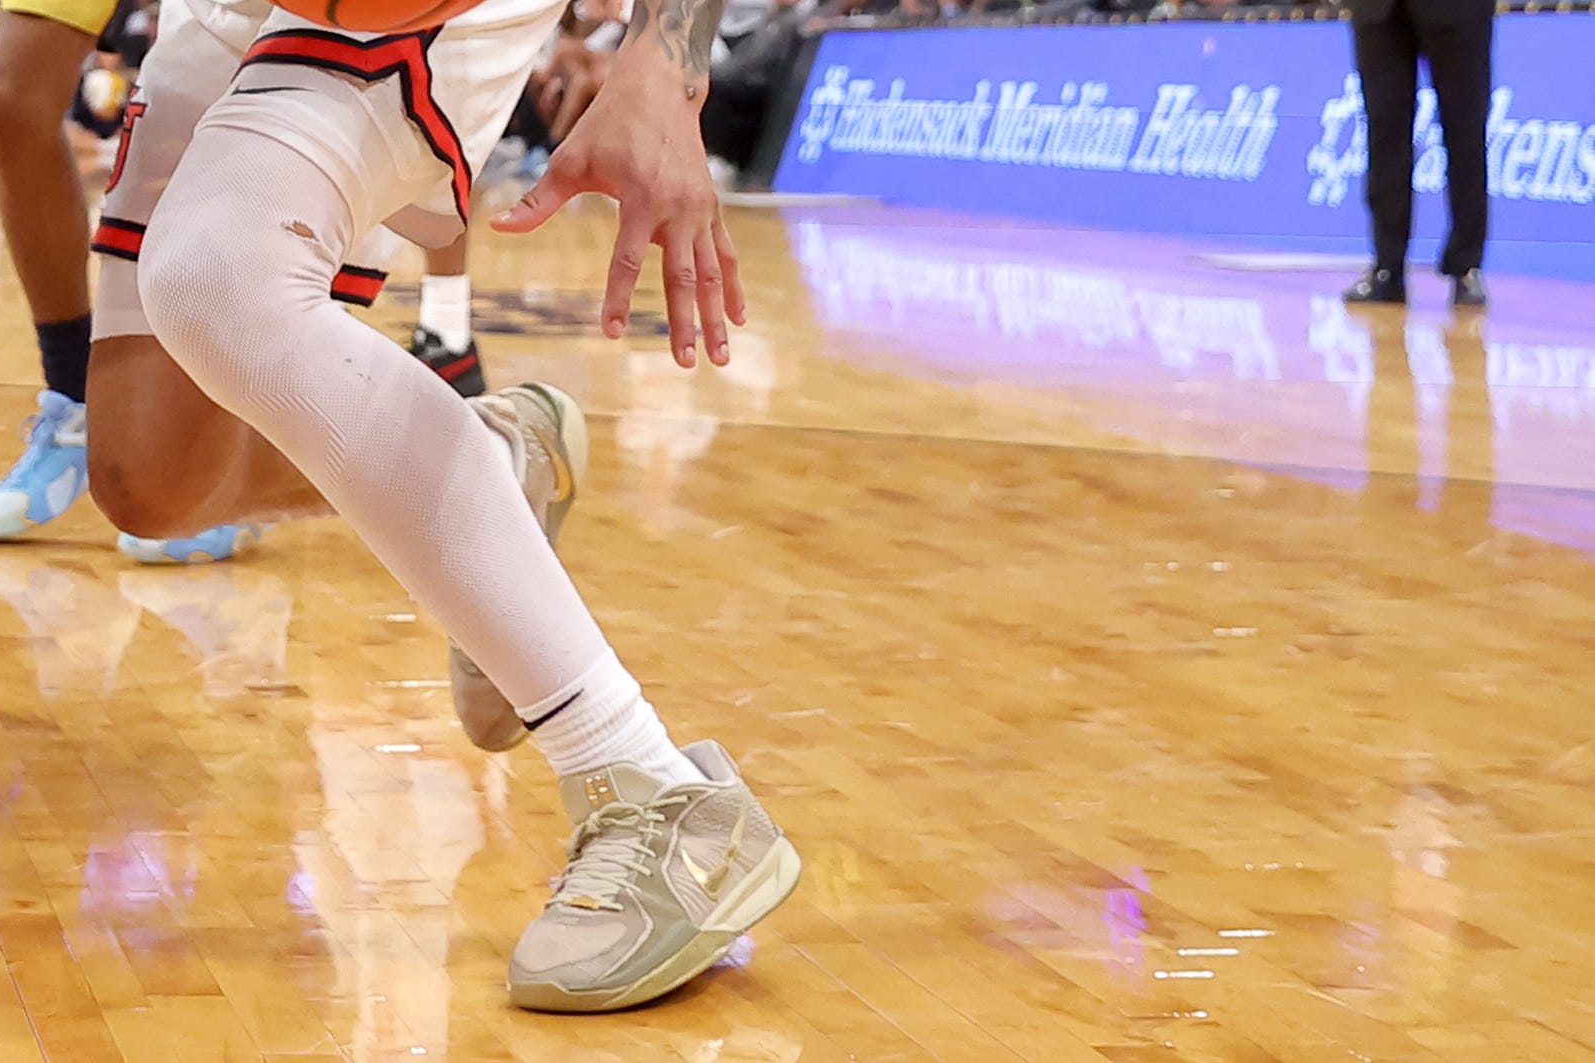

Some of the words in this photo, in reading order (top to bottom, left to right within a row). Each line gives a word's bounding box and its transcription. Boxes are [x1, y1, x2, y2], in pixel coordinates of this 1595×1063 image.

[829, 77, 994, 162] Hackensack
[980, 80, 1141, 173] Meridian
[1129, 83, 1282, 182] Health
